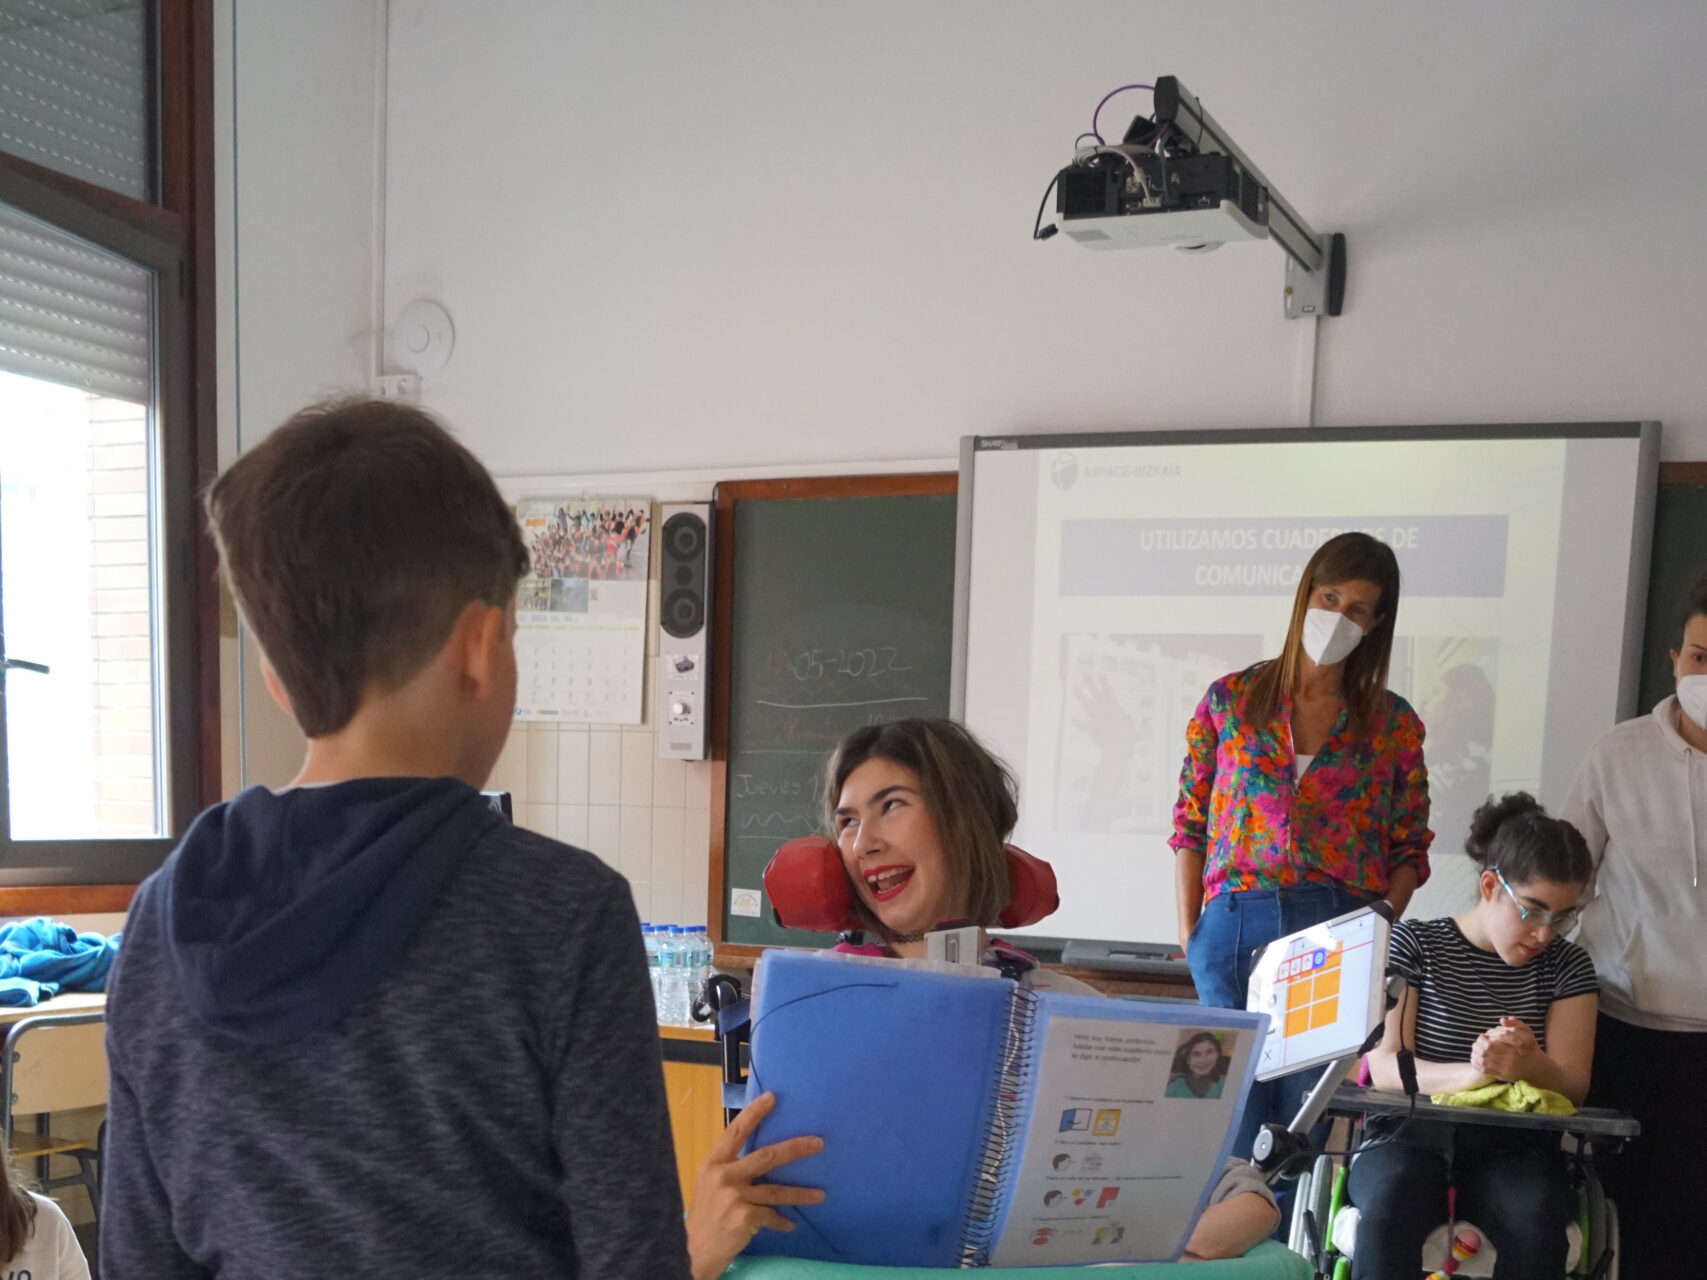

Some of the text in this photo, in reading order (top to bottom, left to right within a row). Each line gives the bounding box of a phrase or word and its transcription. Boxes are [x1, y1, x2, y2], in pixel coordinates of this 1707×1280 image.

[1083, 464, 1182, 479] ASPACE-BIZKAIA
[1140, 527, 1418, 551] UTILIZAMOS CUADES DE
